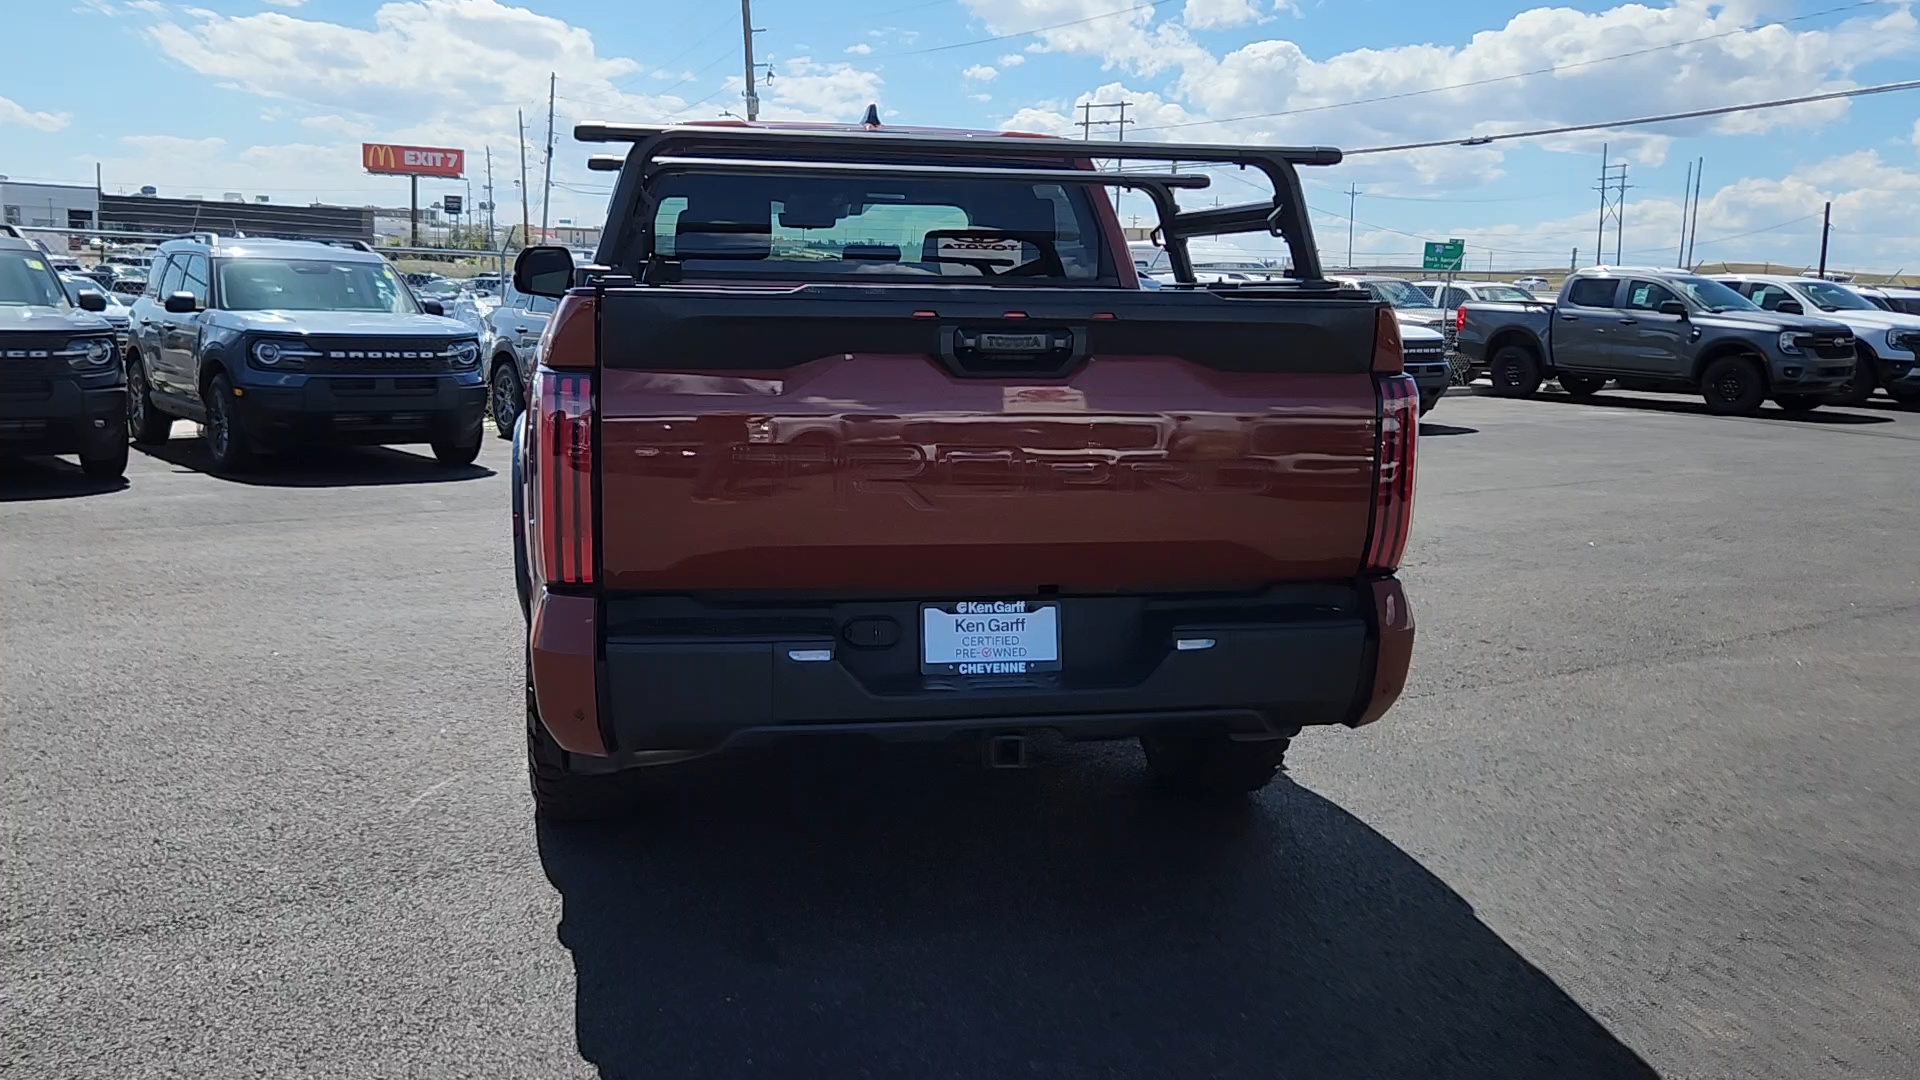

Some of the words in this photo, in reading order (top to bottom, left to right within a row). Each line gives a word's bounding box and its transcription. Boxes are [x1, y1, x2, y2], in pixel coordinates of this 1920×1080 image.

[404, 150, 444, 166] EXIT
[446, 153, 458, 168] 7
[987, 336, 1041, 348] TOYOTA
[0, 350, 48, 358] CO
[330, 350, 434, 358] BRONCO
[968, 602, 993, 613] Ken
[994, 601, 1026, 613] Garff
[955, 619, 985, 633] Ken
[988, 618, 1026, 632] Garff
[962, 635, 1020, 646] CERTIFIED
[959, 662, 1026, 674] CHEYENNE
